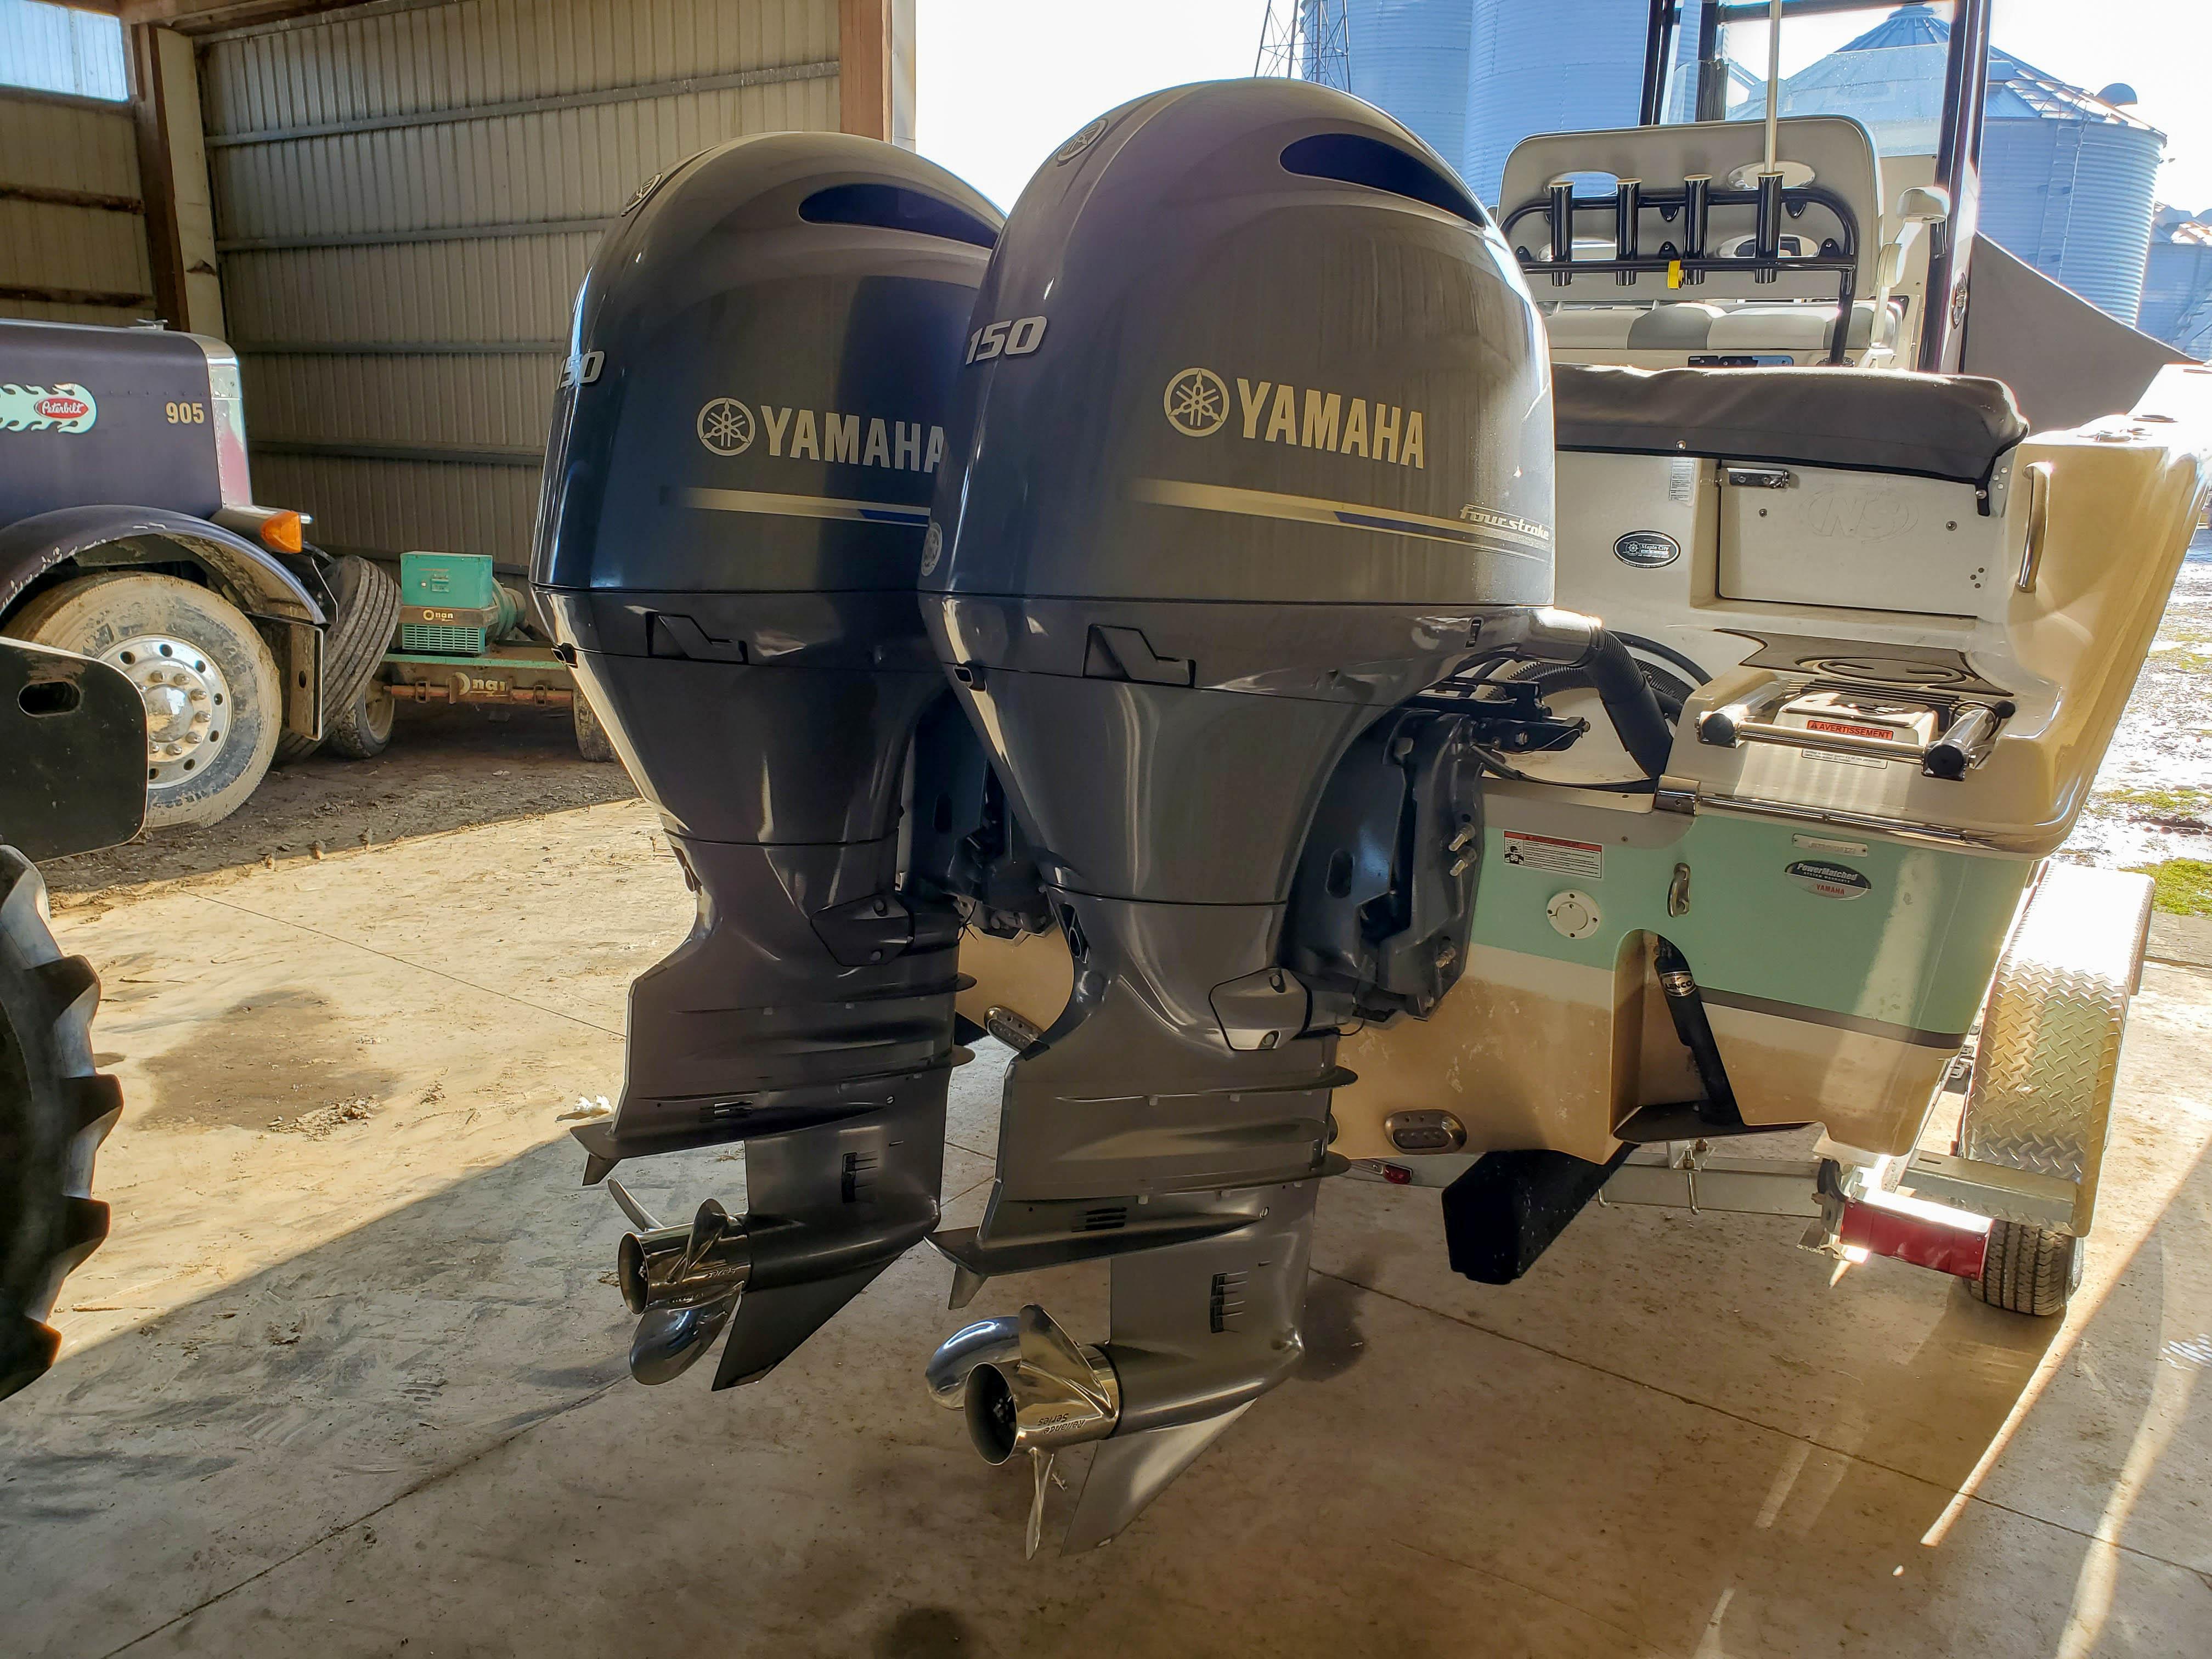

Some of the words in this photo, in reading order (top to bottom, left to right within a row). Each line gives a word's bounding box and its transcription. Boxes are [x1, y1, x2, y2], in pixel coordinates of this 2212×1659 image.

[966, 316, 1047, 365] 150
[42, 400, 84, 414] Peterbilt
[166, 402, 205, 424] 905
[1237, 377, 1424, 470] YAMAHA
[760, 405, 945, 473] YAMAHA
[1641, 544, 1657, 552] Maple
[1658, 545, 1669, 553] City
[422, 610, 454, 621] Onan
[1820, 723, 1890, 739] AVERTISSEMENT
[1797, 863, 1858, 881] PowerMatched
[1816, 883, 1845, 895] YAMAHA
[1664, 980, 1692, 990] LENCO
[1037, 1413, 1069, 1426] Series
